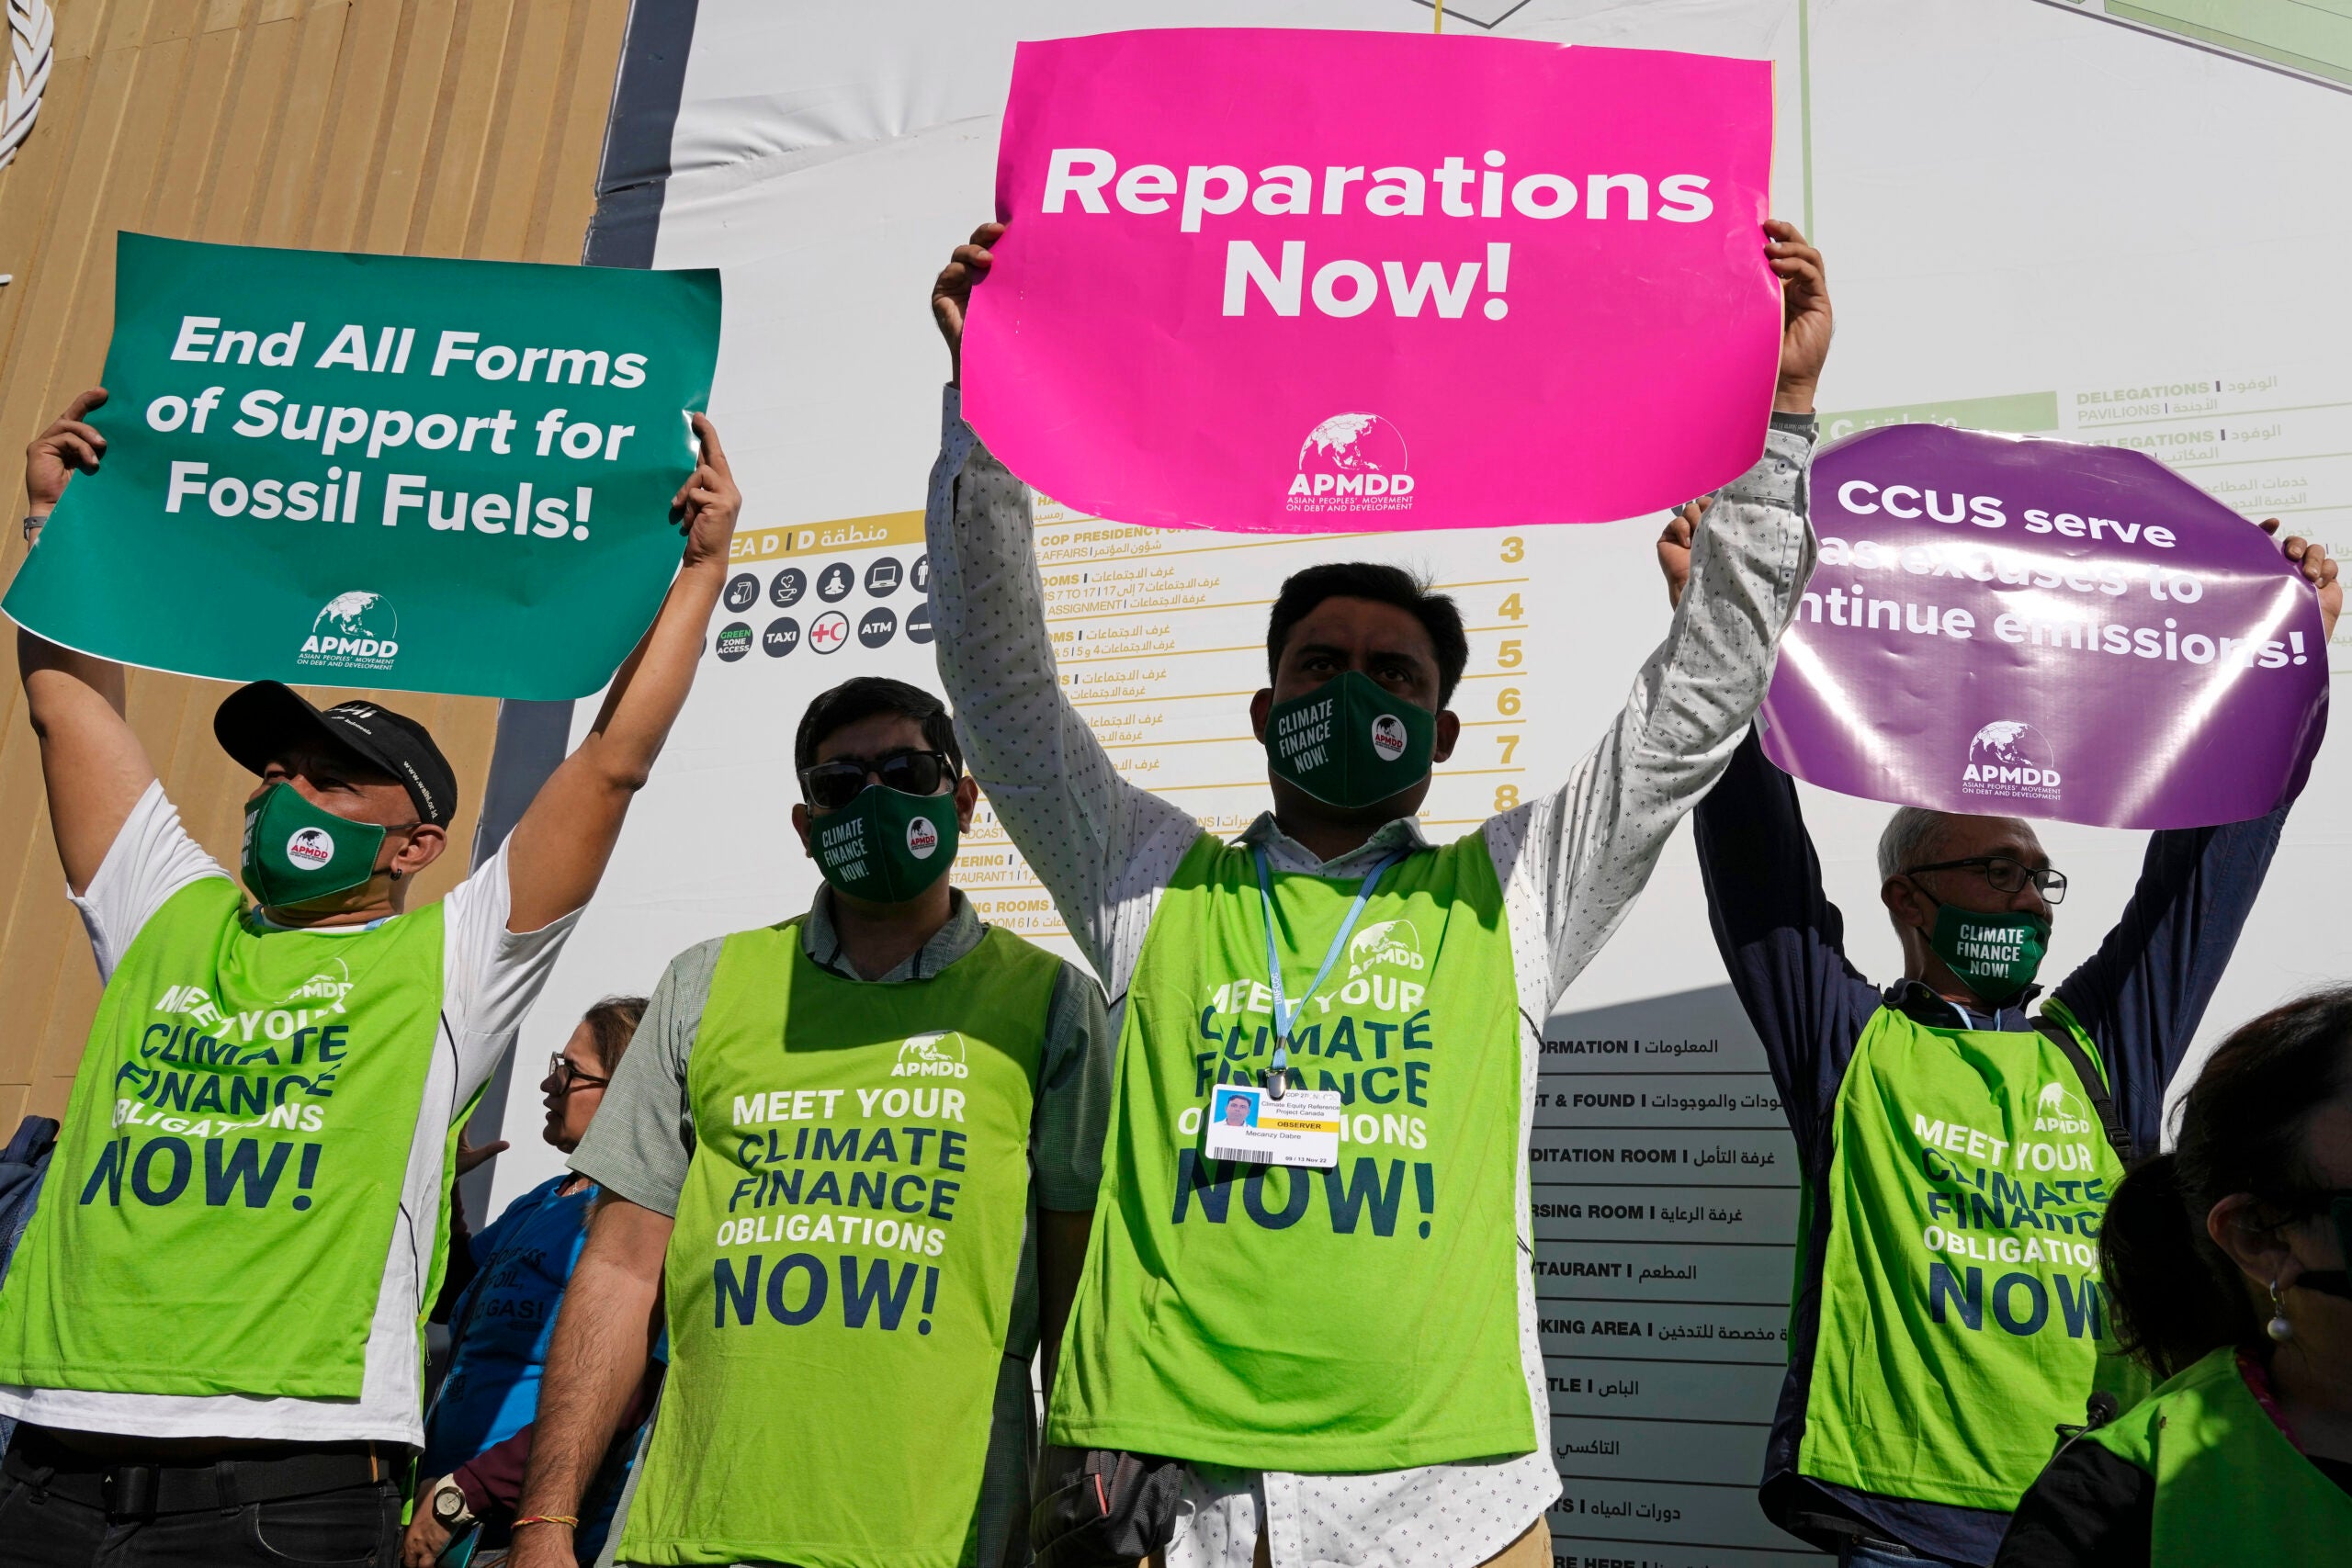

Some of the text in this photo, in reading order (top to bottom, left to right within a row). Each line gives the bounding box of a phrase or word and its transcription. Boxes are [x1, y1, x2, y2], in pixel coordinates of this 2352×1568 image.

[1041, 148, 1715, 233] Reparations
[1222, 239, 1511, 321] Now!
[170, 315, 649, 389] End All Forms
[2076, 382, 2210, 404] DELEGATIONS
[145, 386, 636, 461] of Support for
[2078, 403, 2160, 423] PAVILIONS
[1288, 473, 1415, 496] APMDD
[164, 460, 593, 541] Fossil Fuels!
[1350, 503, 1413, 512] DEVELOPMENT
[1363, 496, 1414, 504] MOVEMENT
[1838, 480, 2177, 548] CCUS serve
[761, 531, 815, 552] D D
[820, 525, 888, 547] منطقة
[1041, 535, 1070, 547] COP
[1042, 548, 1088, 560] AFFAIRS
[1500, 536, 1524, 563] 3
[1820, 536, 1893, 570] as
[2144, 562, 2205, 605] to
[1067, 590, 1080, 600] TO
[1083, 588, 1096, 598] 17
[1047, 600, 1123, 615] ASSIGNMENT
[1498, 593, 1523, 620] 4
[720, 629, 752, 639] GREEN
[766, 631, 797, 644] TAXI
[861, 622, 893, 635] ATM
[1794, 584, 2308, 670] ntinue emissions!
[300, 635, 399, 658] APMDD
[717, 644, 751, 655] ACCESS
[722, 637, 746, 647] ZONE
[356, 657, 394, 665] MOVEMENT
[1498, 640, 1522, 668] 5
[345, 662, 393, 671] DEVELOPMENT
[1497, 688, 1521, 716] 6
[1278, 698, 1333, 737] CLIMATE
[1279, 720, 1331, 759] FINANCE
[1375, 734, 1403, 748] APMDD
[1497, 735, 1520, 764] 7
[1295, 745, 1329, 774] NOW!
[1962, 763, 2061, 787] APMDD
[1494, 784, 1519, 812] 8
[2012, 791, 2061, 801] DEVELOPMENT
[2020, 786, 2061, 795] MOVEMENT
[822, 817, 864, 848] CLIMATE
[910, 835, 935, 846] APMDD
[291, 844, 328, 859] APMDD
[824, 838, 868, 867] FINANCE
[954, 854, 1004, 867] TERING
[840, 859, 869, 883] NOW!
[996, 900, 1049, 913] ROOMS
[1960, 924, 2025, 944] CLIMATE
[1957, 941, 2020, 962] FINANCE
[1347, 948, 1424, 979] APMDD
[1970, 960, 2009, 978] NOW!
[1314, 975, 1425, 1014] YOUR
[141, 1023, 349, 1066] CLIMATE
[1200, 1005, 1433, 1062] CLIMATE
[1645, 1040, 1718, 1056] المعلومات
[890, 1061, 968, 1078] APMDD
[116, 1060, 342, 1116] FINANCE
[733, 1088, 966, 1126] MEET YOUR
[1286, 1102, 1306, 1111] Equity
[1555, 1094, 1567, 1108] &
[1573, 1094, 1635, 1108] FOUND
[1277, 1121, 1322, 1130] OBSERVER
[737, 1127, 967, 1173] CLIMATE
[1914, 1113, 2094, 1173] MEET YOUR
[1531, 1149, 1677, 1164] DITATION ROOM
[80, 1135, 322, 1211] NOW!
[729, 1168, 960, 1222] FINANCE
[1171, 1147, 1434, 1240] NOW!
[1532, 1204, 1644, 1220] RSING ROOM
[1927, 1191, 2102, 1239] FINANC
[717, 1214, 946, 1257] OBLIGATIONS
[1924, 1225, 2099, 1274] OBLIGATIO
[1536, 1261, 1623, 1278] TAURANT
[713, 1252, 940, 1336] NOW!
[487, 1299, 544, 1319] GAS!
[1537, 1319, 1642, 1337] KING AREA
